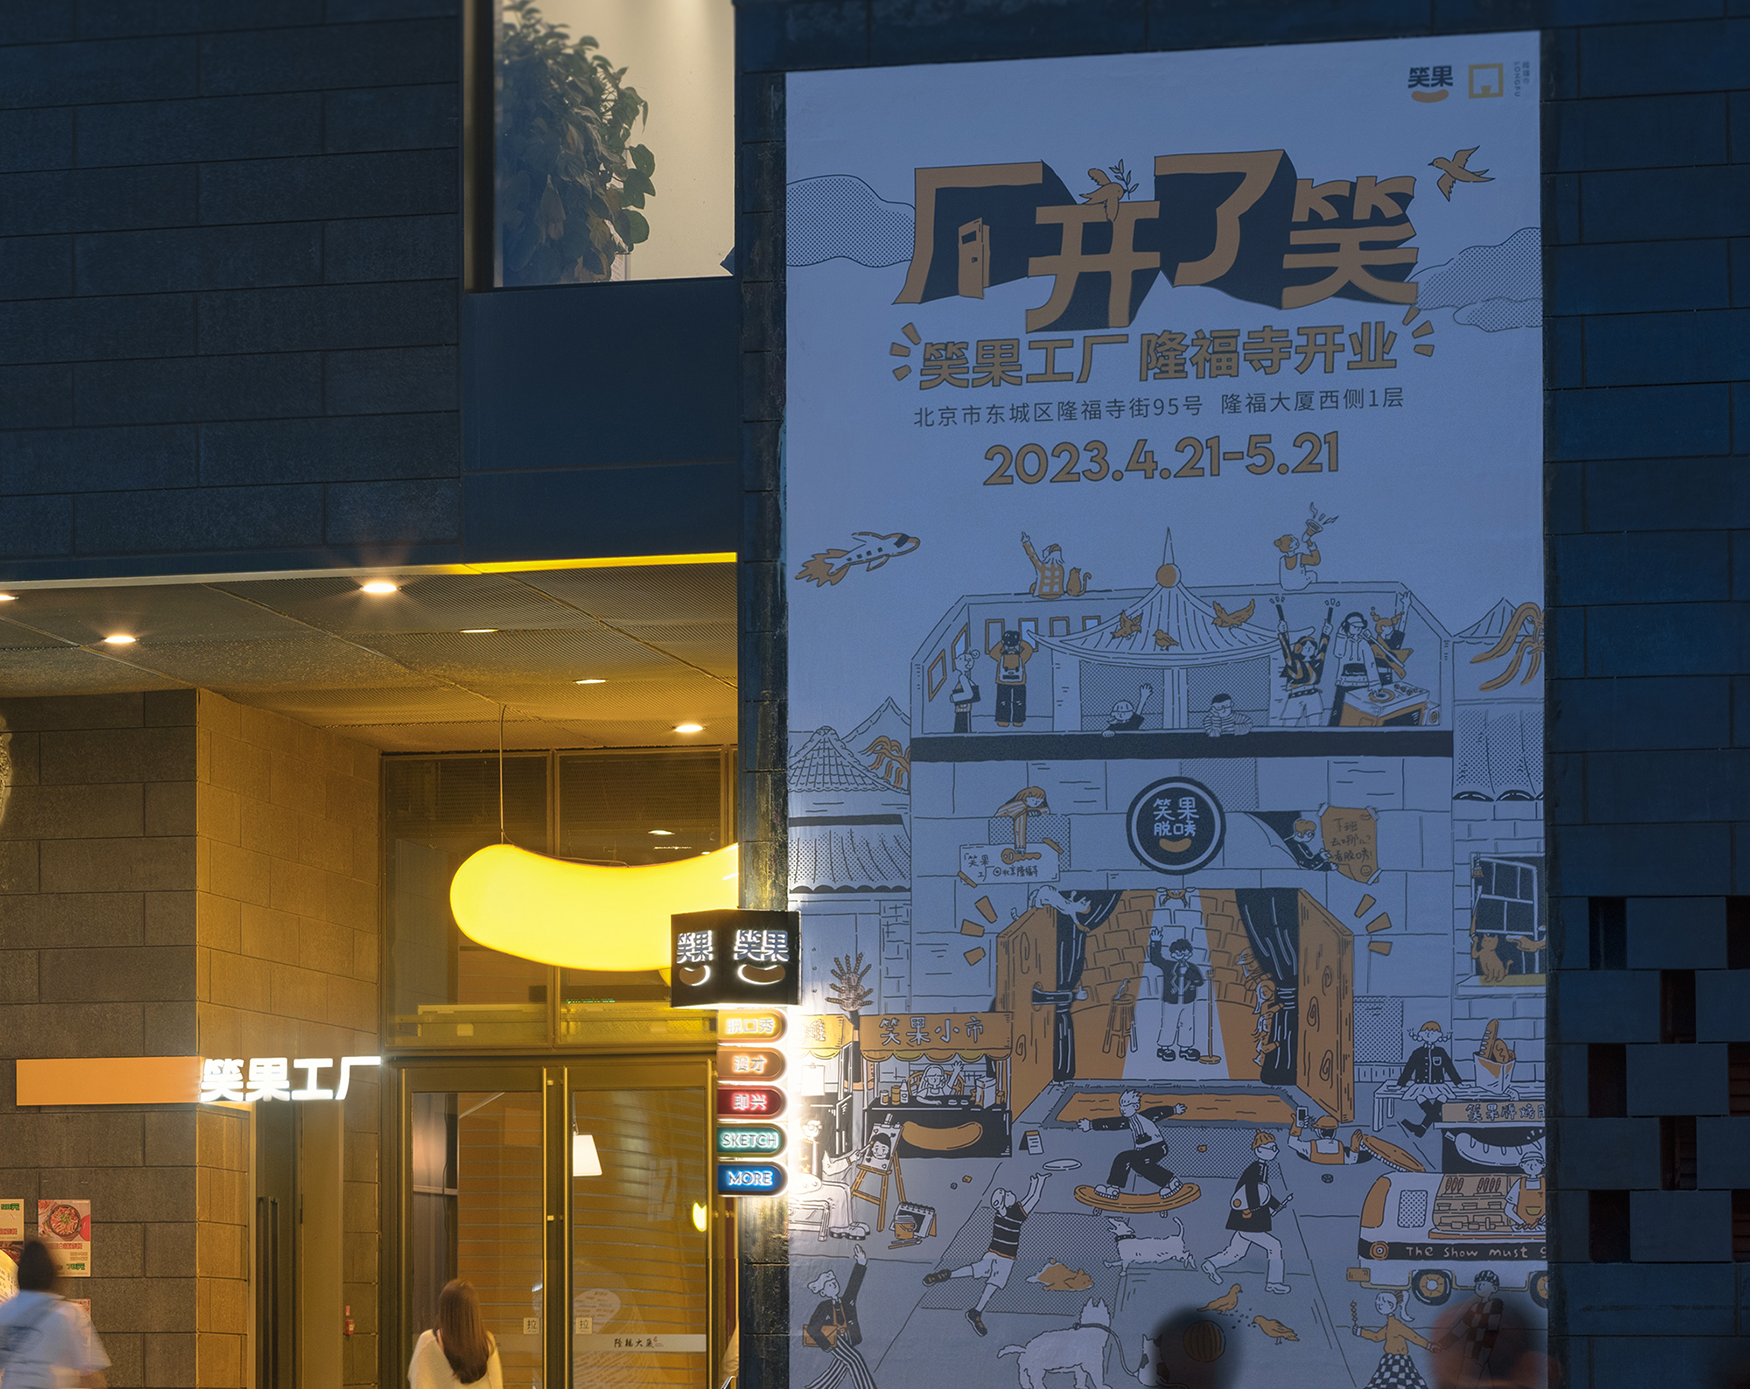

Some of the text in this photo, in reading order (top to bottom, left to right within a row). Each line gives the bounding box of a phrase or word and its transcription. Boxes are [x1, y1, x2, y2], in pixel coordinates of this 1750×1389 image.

[1408, 65, 1453, 88] 笑果
[918, 321, 1398, 390] 笑果工厂 隆福寺开业
[913, 387, 1405, 429] 北京市东城区隆福寺街95号 隆福大厦西侧1层
[982, 430, 1340, 486] 2023.4.21-5.21
[1153, 796, 1199, 820] 笑果
[733, 928, 790, 963] 笑果
[878, 1015, 984, 1046] 笑果小市
[199, 1055, 382, 1102] 笑果工厂
[733, 1093, 767, 1111] 即兴
[722, 1132, 778, 1148] SKETCH
[728, 1170, 773, 1187] MORE
[1406, 1246, 1434, 1257] The
[1488, 1247, 1528, 1258] must
